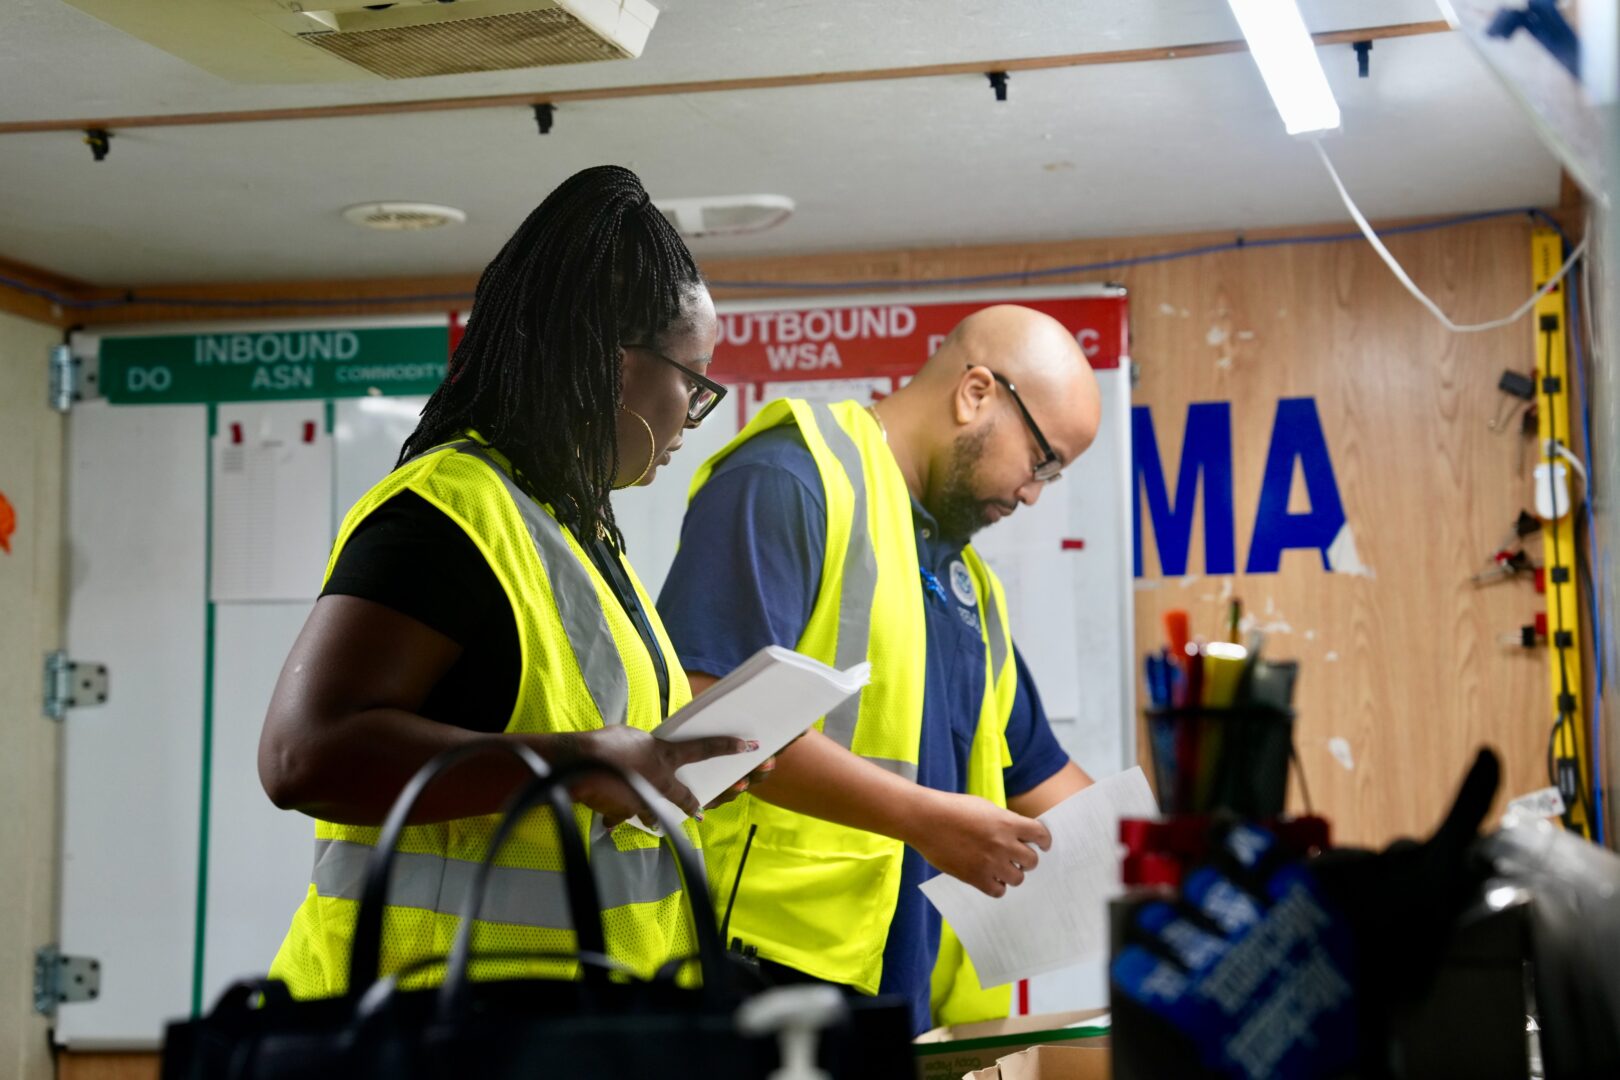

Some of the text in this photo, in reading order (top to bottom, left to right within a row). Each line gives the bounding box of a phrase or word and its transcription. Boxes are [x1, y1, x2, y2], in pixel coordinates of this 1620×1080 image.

[195, 332, 359, 365] INBOUND
[766, 341, 842, 371] WSA
[126, 365, 172, 391] DO
[251, 363, 314, 389] ASN
[1131, 396, 1347, 578] MA
